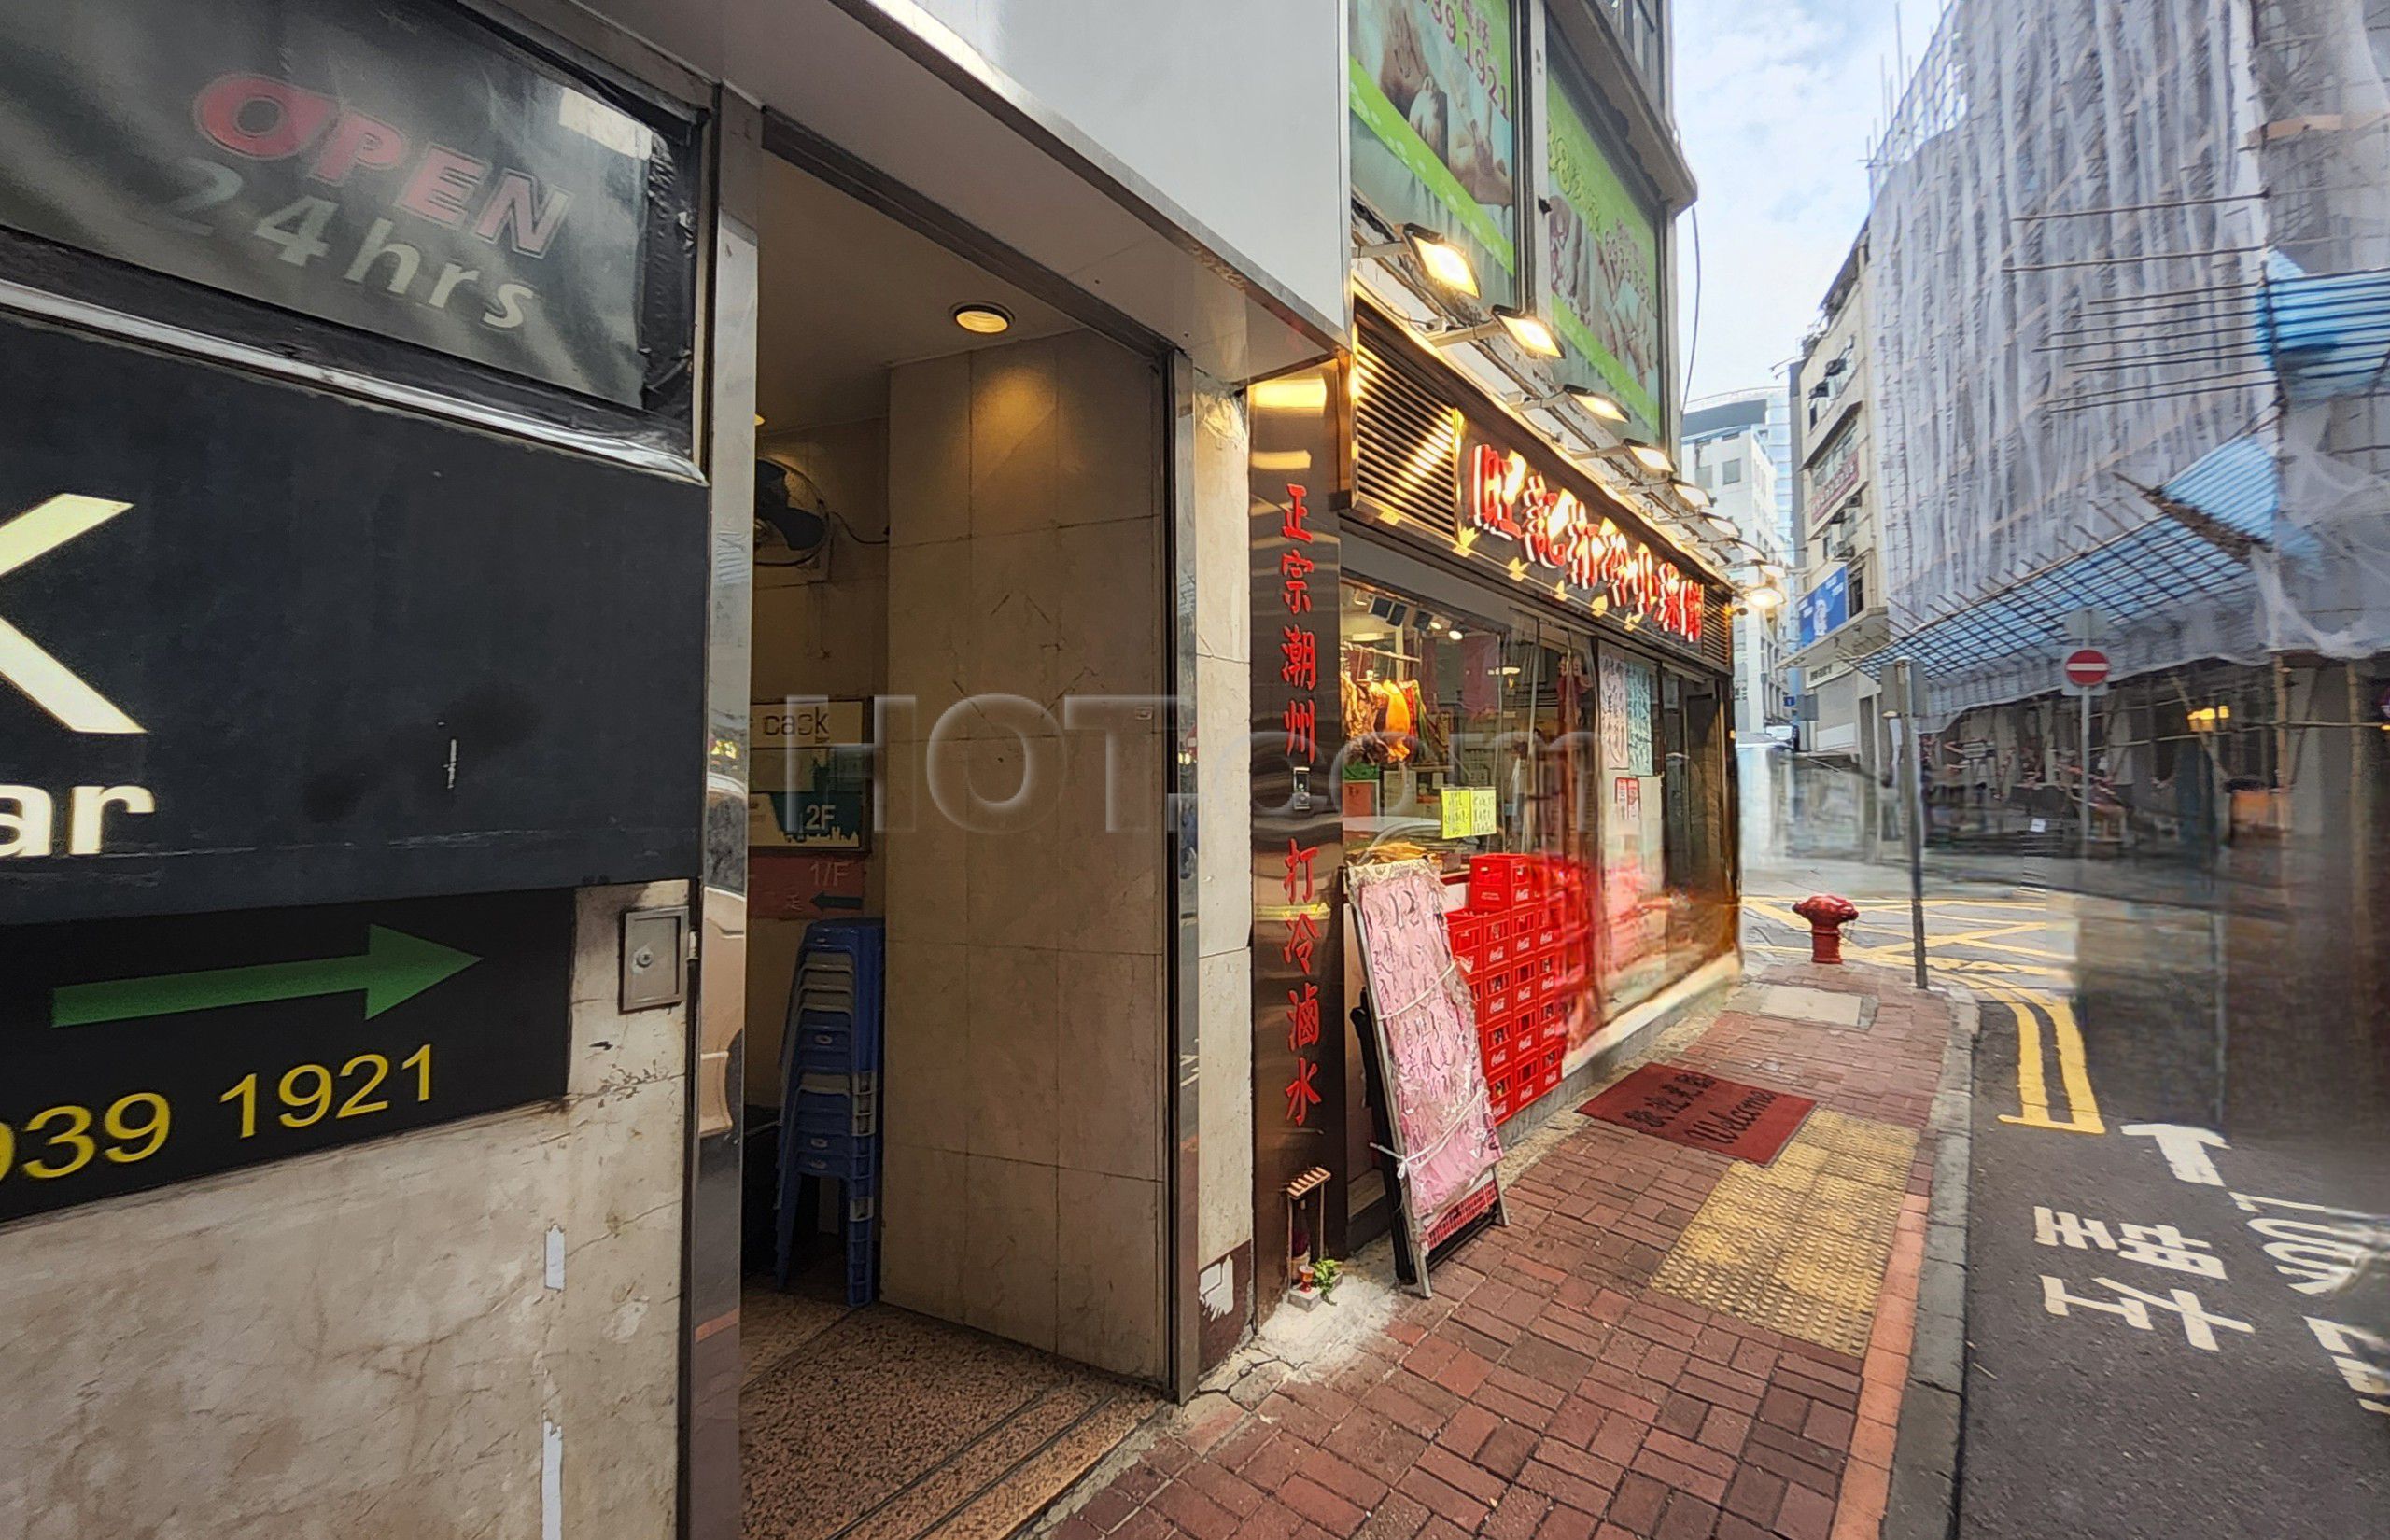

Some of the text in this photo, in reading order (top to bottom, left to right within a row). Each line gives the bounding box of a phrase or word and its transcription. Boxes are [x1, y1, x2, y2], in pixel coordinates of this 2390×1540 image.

[192, 71, 572, 259] OPEN
[805, 804, 836, 831] 2F
[0, 1043, 432, 1183] 39 1921
